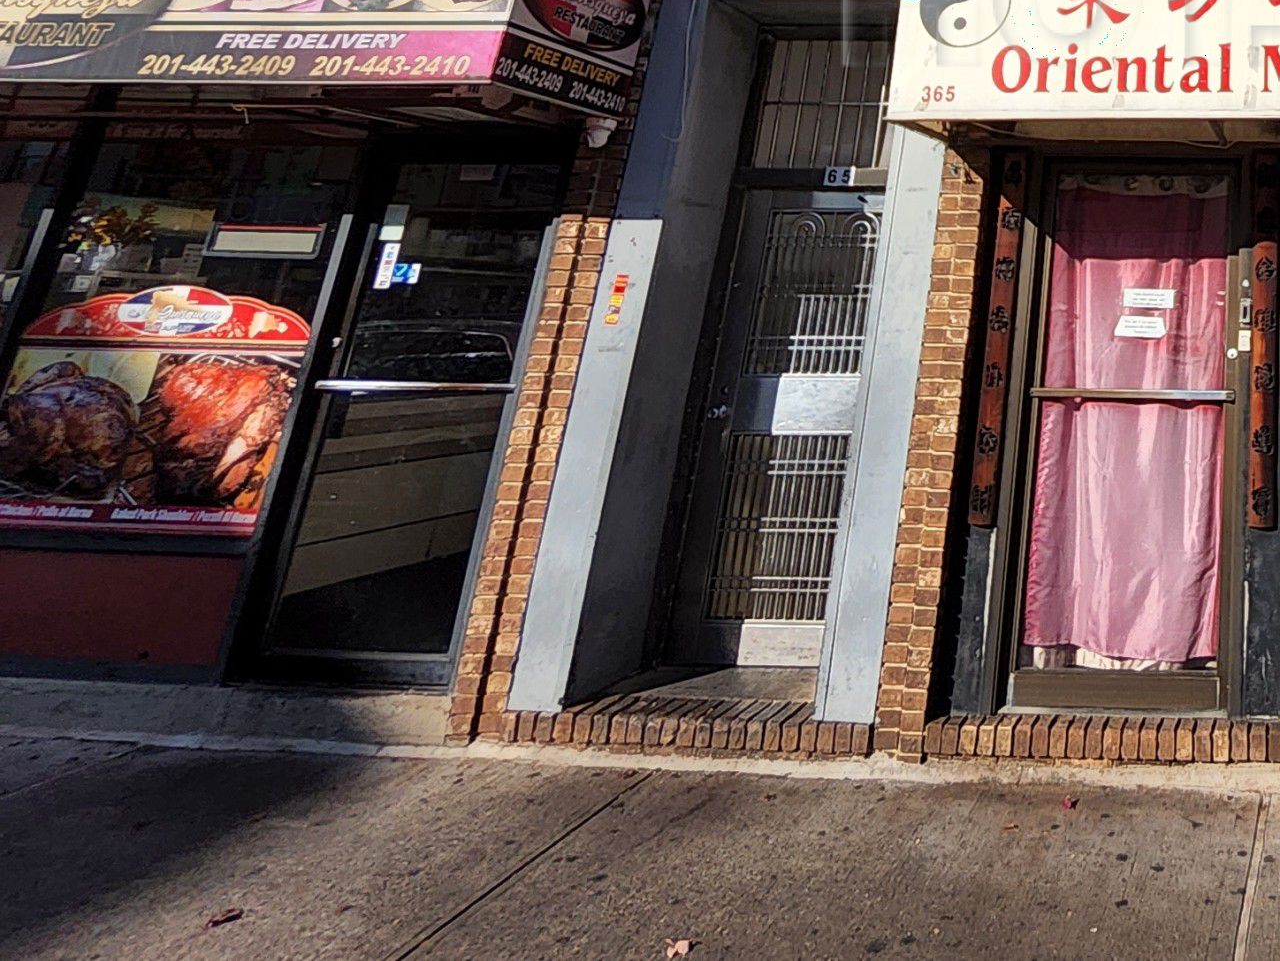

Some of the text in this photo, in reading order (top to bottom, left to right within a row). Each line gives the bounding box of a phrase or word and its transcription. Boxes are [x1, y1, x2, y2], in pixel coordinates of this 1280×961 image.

[215, 34, 407, 50] FREE DELIVERY
[555, 6, 626, 44] RESTAURANT
[137, 54, 473, 77] 201-443-2409 201-443-2410
[525, 43, 622, 87] FREE DELIVERY
[991, 43, 1234, 94] Oriental
[495, 57, 626, 113] 201-443-2409 201-443-2410
[921, 85, 956, 103] 365
